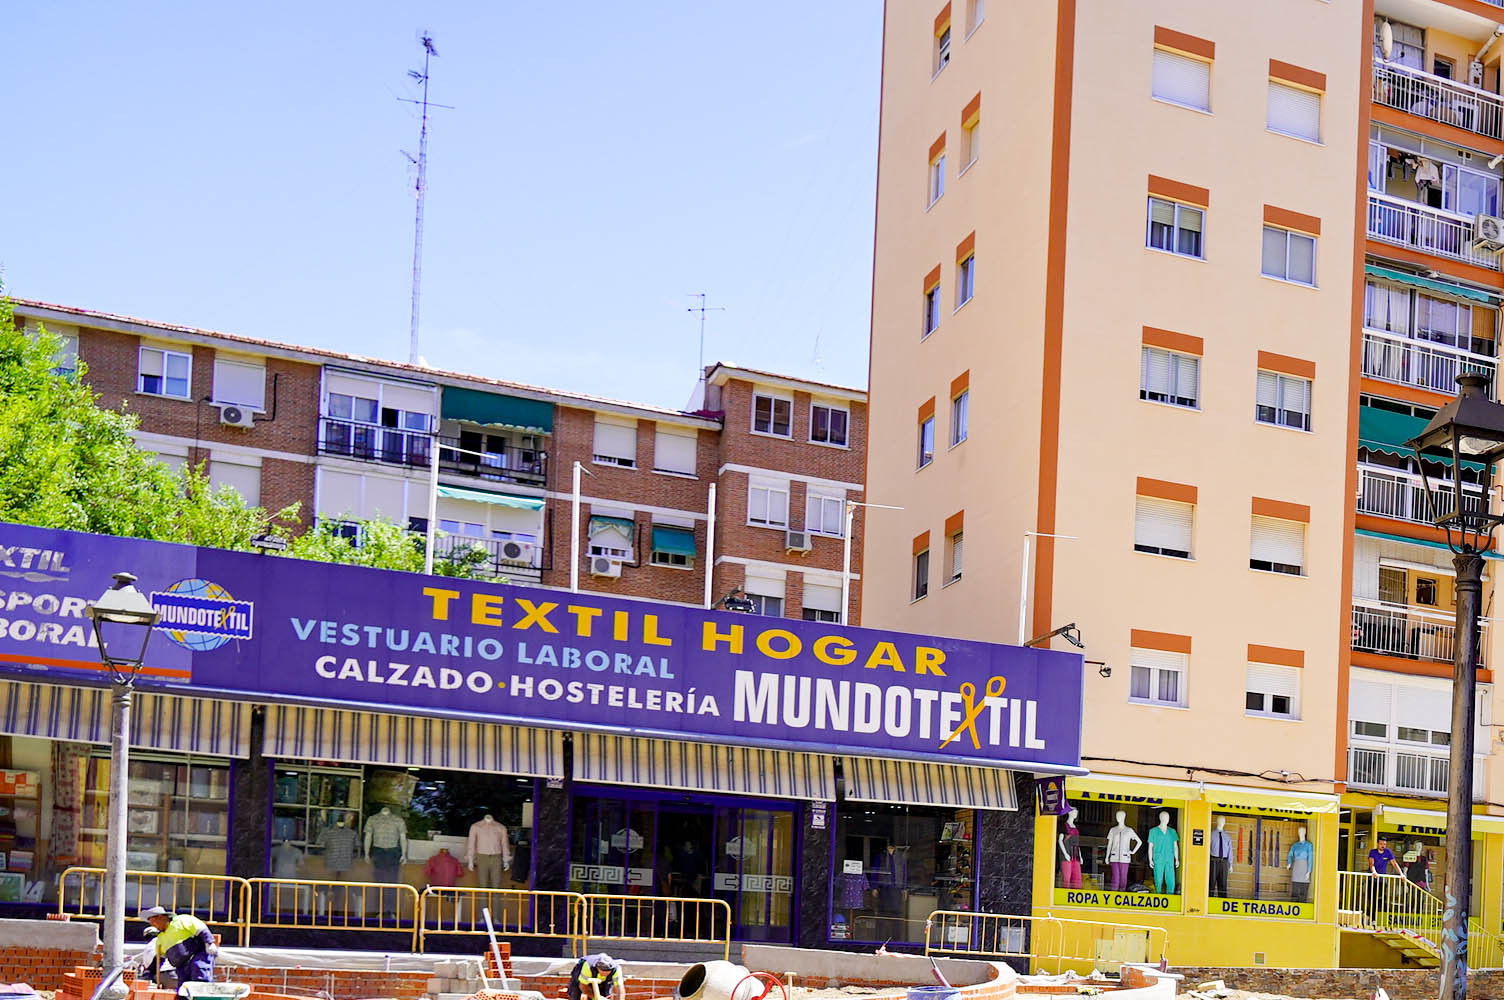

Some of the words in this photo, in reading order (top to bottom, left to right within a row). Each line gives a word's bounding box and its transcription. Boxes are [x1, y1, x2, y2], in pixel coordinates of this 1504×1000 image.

[0, 590, 97, 619] POR
[153, 603, 249, 631] MUNDOTEXTIL
[423, 587, 673, 647] TEXTIL
[702, 621, 947, 677] HOGAR
[290, 617, 504, 661] VESTUARIO
[518, 642, 675, 680] LABORAL
[733, 669, 1046, 750] MUNDOTEXTIL
[1067, 891, 1099, 905] ROPA
[1102, 894, 1111, 905] Y
[1114, 894, 1169, 908] CALZADO
[1222, 901, 1238, 913] DE
[1242, 902, 1300, 916] TRABAJO
